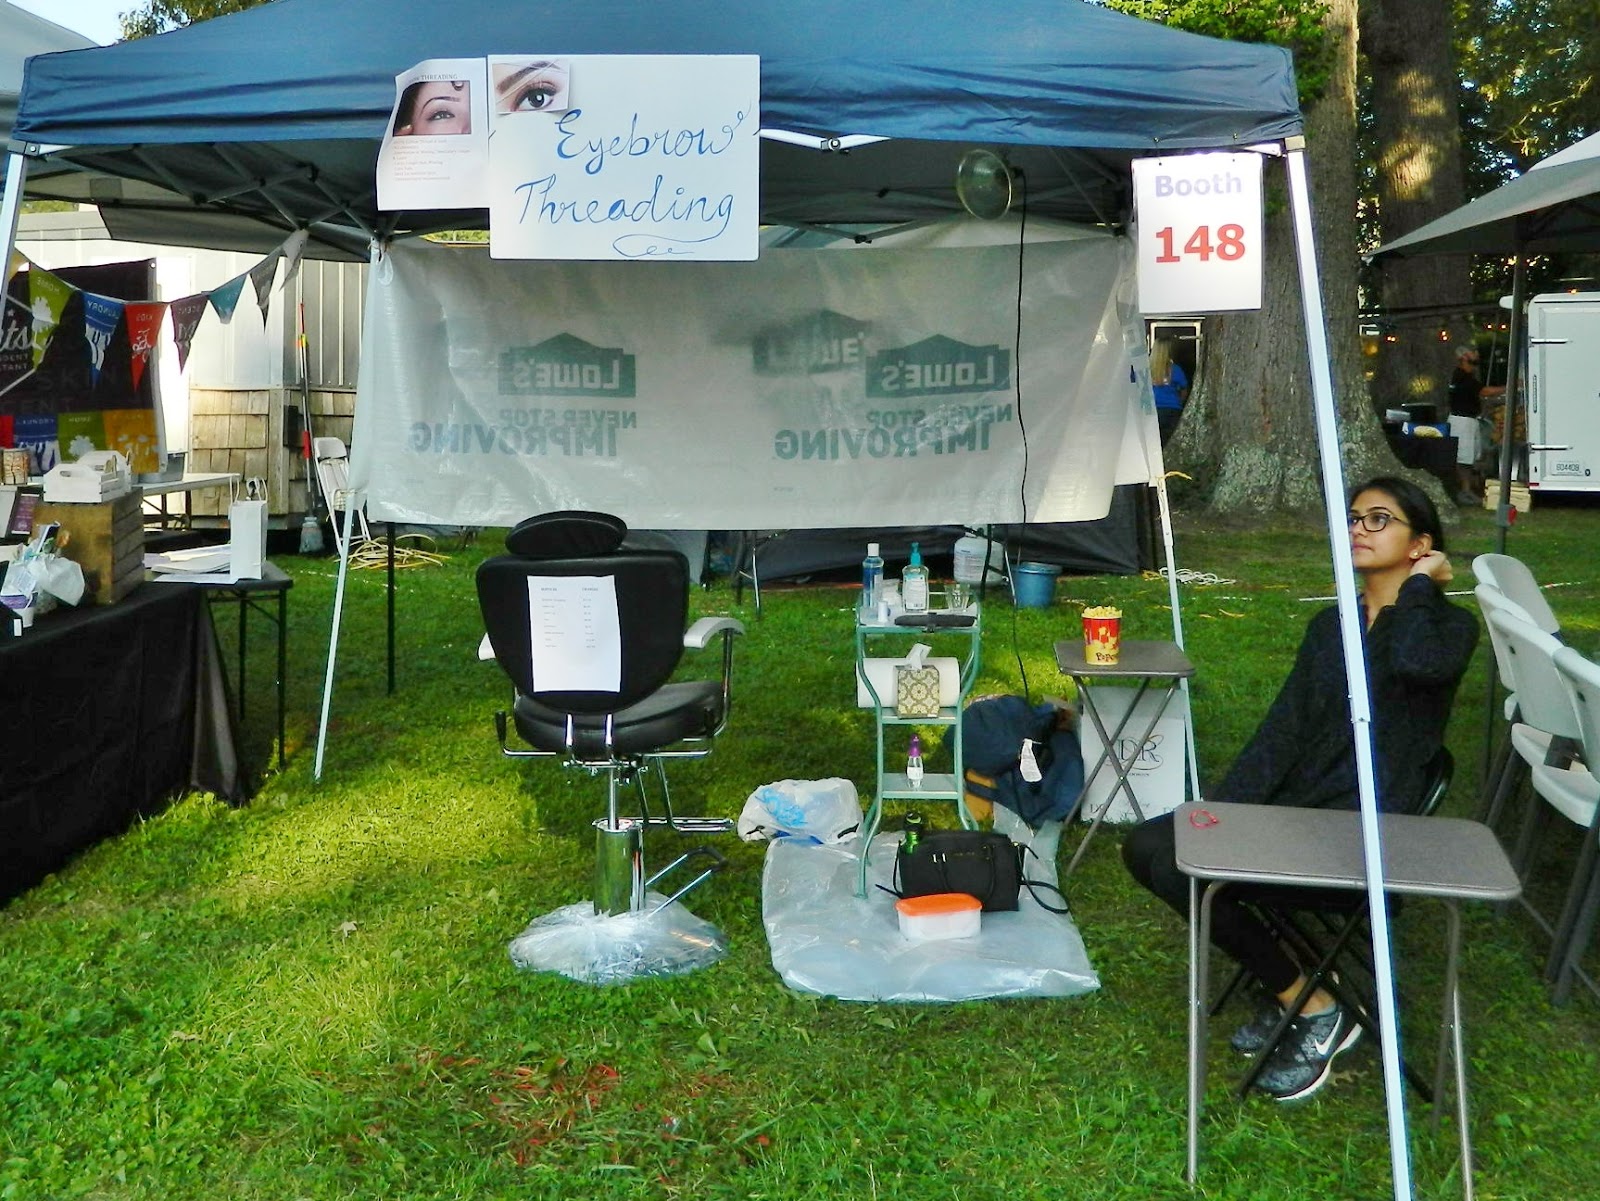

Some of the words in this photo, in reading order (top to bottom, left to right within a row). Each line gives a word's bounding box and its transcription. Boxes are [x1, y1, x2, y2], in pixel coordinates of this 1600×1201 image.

[421, 73, 458, 81] THREADING
[554, 108, 746, 175] Eyebrow
[1155, 172, 1242, 198] Booth
[514, 174, 734, 243] Threading
[1155, 223, 1246, 263] 148
